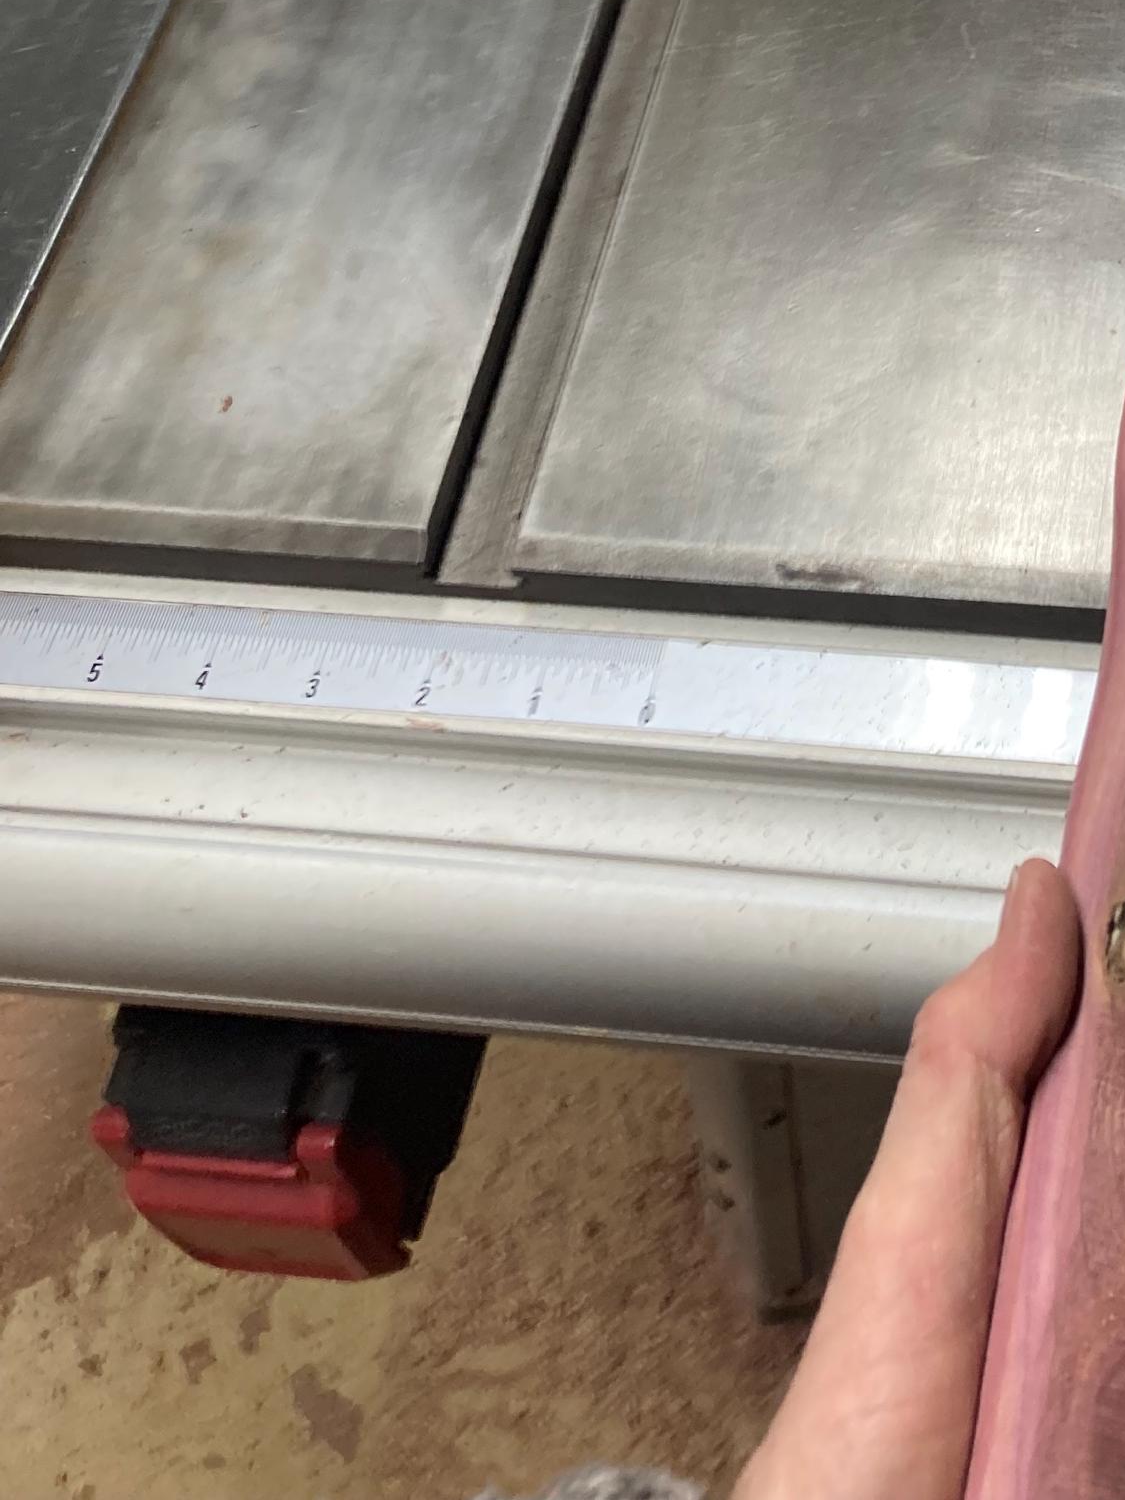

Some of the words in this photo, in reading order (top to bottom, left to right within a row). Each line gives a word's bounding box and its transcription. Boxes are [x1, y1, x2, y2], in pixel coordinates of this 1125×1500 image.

[87, 662, 103, 683] 5
[194, 670, 209, 690] 4
[305, 678, 320, 698] 3
[414, 686, 431, 707] 2
